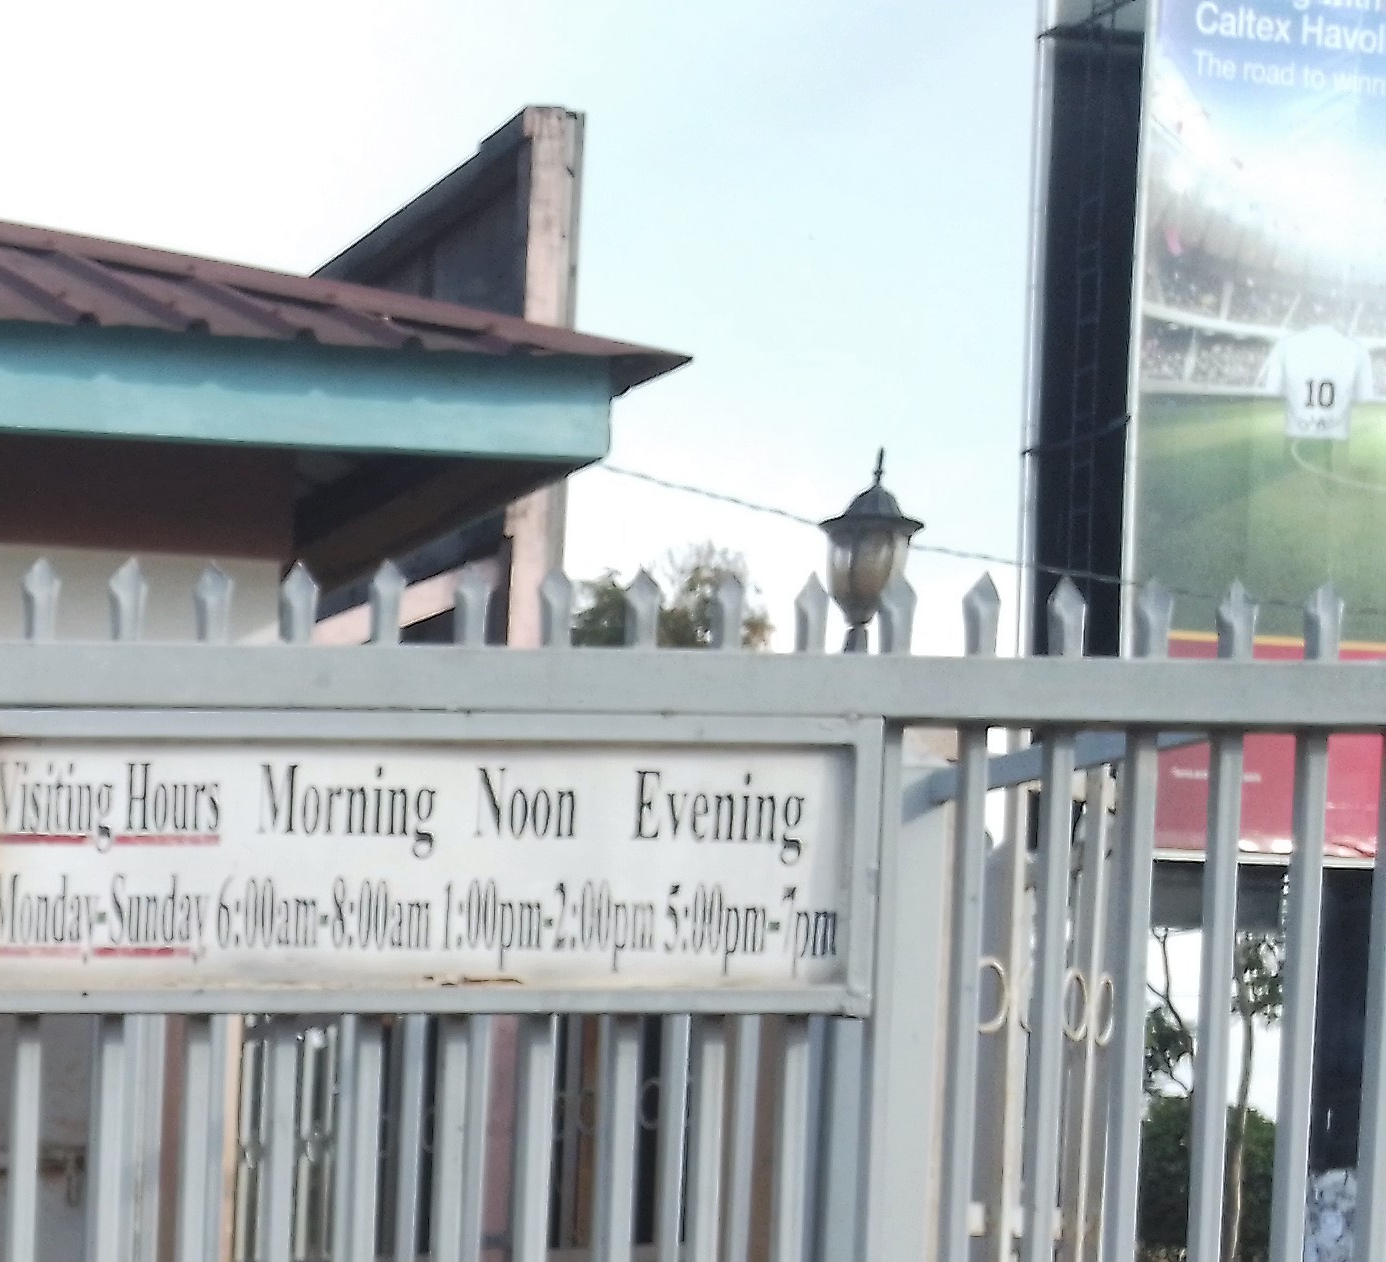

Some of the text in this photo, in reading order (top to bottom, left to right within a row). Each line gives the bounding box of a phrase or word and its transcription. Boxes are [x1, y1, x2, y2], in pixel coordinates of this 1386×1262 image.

[1195, 1, 1386, 54] Caltex Havol
[1192, 49, 1237, 80] The
[1242, 61, 1295, 86] road
[1301, 64, 1326, 89] to
[1306, 379, 1335, 408] 10
[127, 762, 220, 832] Hours
[258, 763, 436, 860] Morning
[476, 766, 576, 839] Noon
[633, 770, 805, 866] Evening
[217, 875, 431, 950] 6:00am-8:00am
[443, 878, 655, 972] 1:00pm-2:00pm
[665, 883, 837, 981] 5:00pm-7pm
